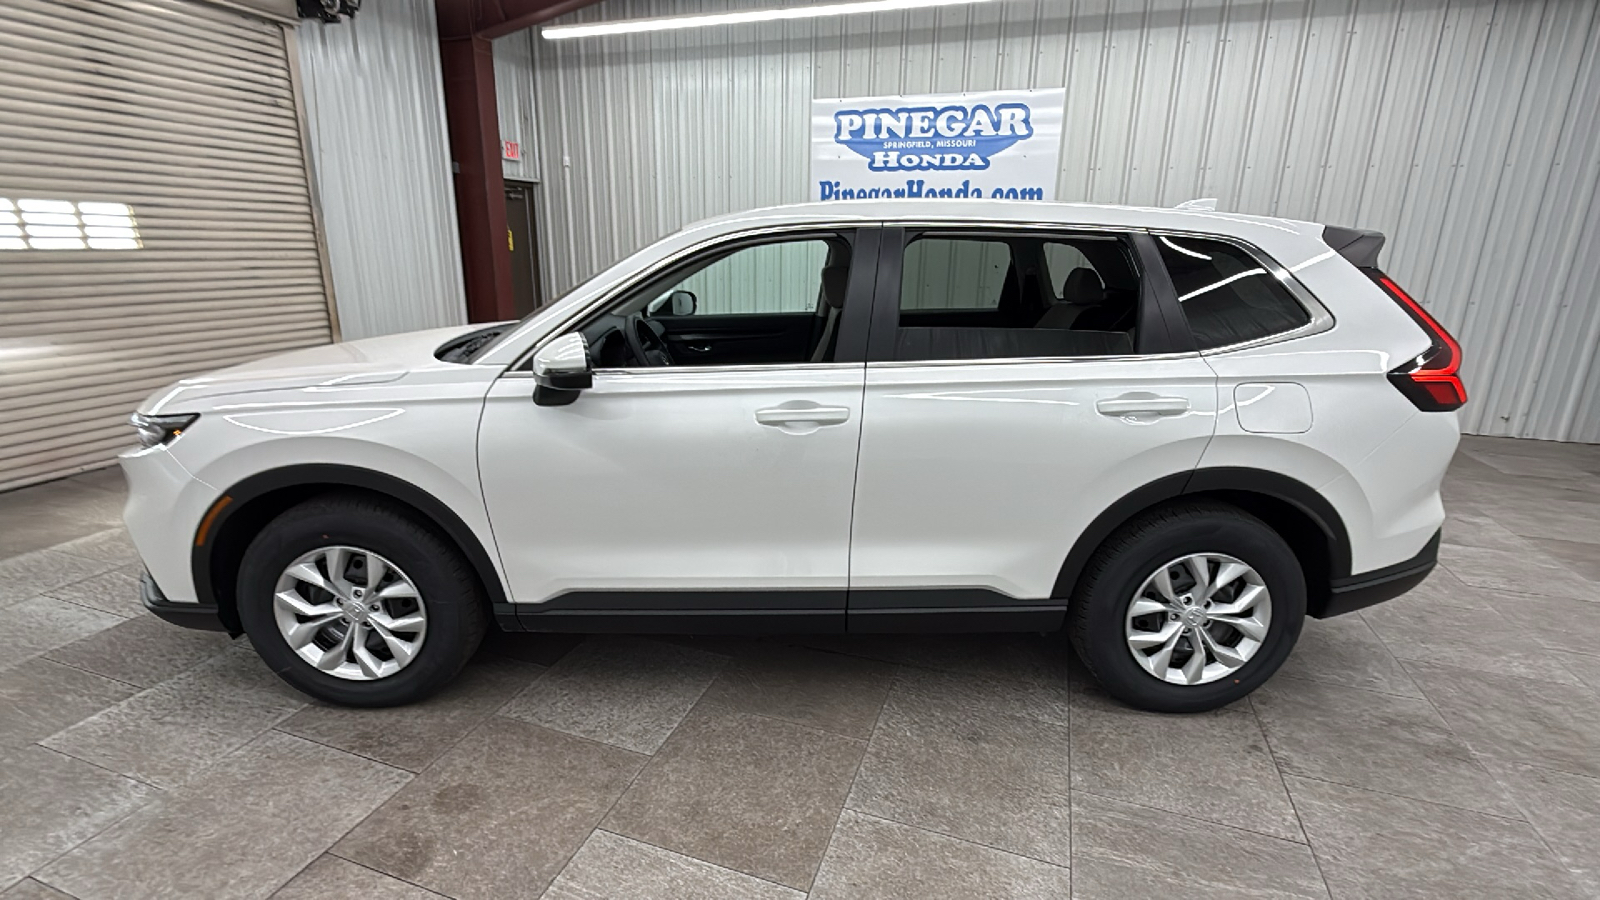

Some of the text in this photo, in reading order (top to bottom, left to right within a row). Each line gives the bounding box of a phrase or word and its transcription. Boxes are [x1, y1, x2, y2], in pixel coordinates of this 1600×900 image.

[837, 107, 1029, 140] PINEGAR
[883, 139, 976, 149] SPRINGFIELD, MISSOURI
